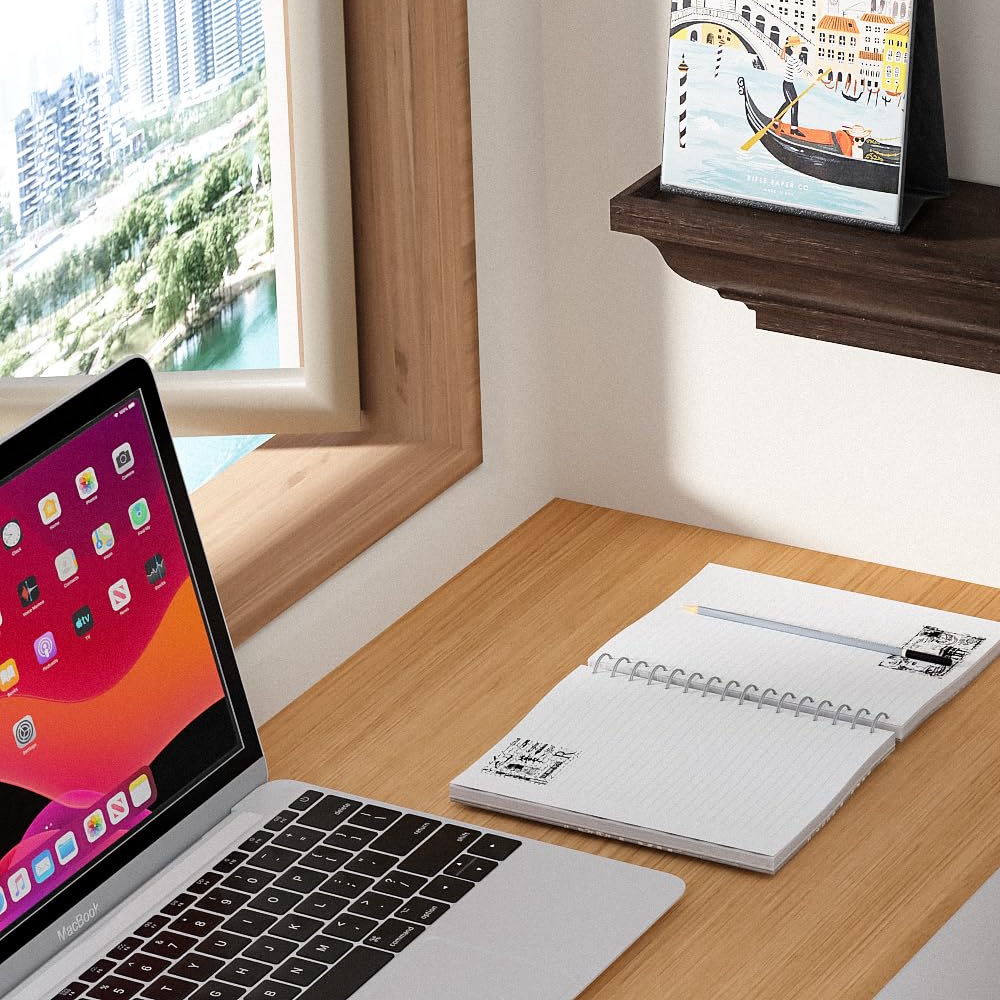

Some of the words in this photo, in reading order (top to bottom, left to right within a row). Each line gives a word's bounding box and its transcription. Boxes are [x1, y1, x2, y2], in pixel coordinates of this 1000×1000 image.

[413, 822, 431, 835] return
[421, 905, 438, 920] option
[57, 903, 100, 942] MacBook
[389, 926, 415, 948] command
